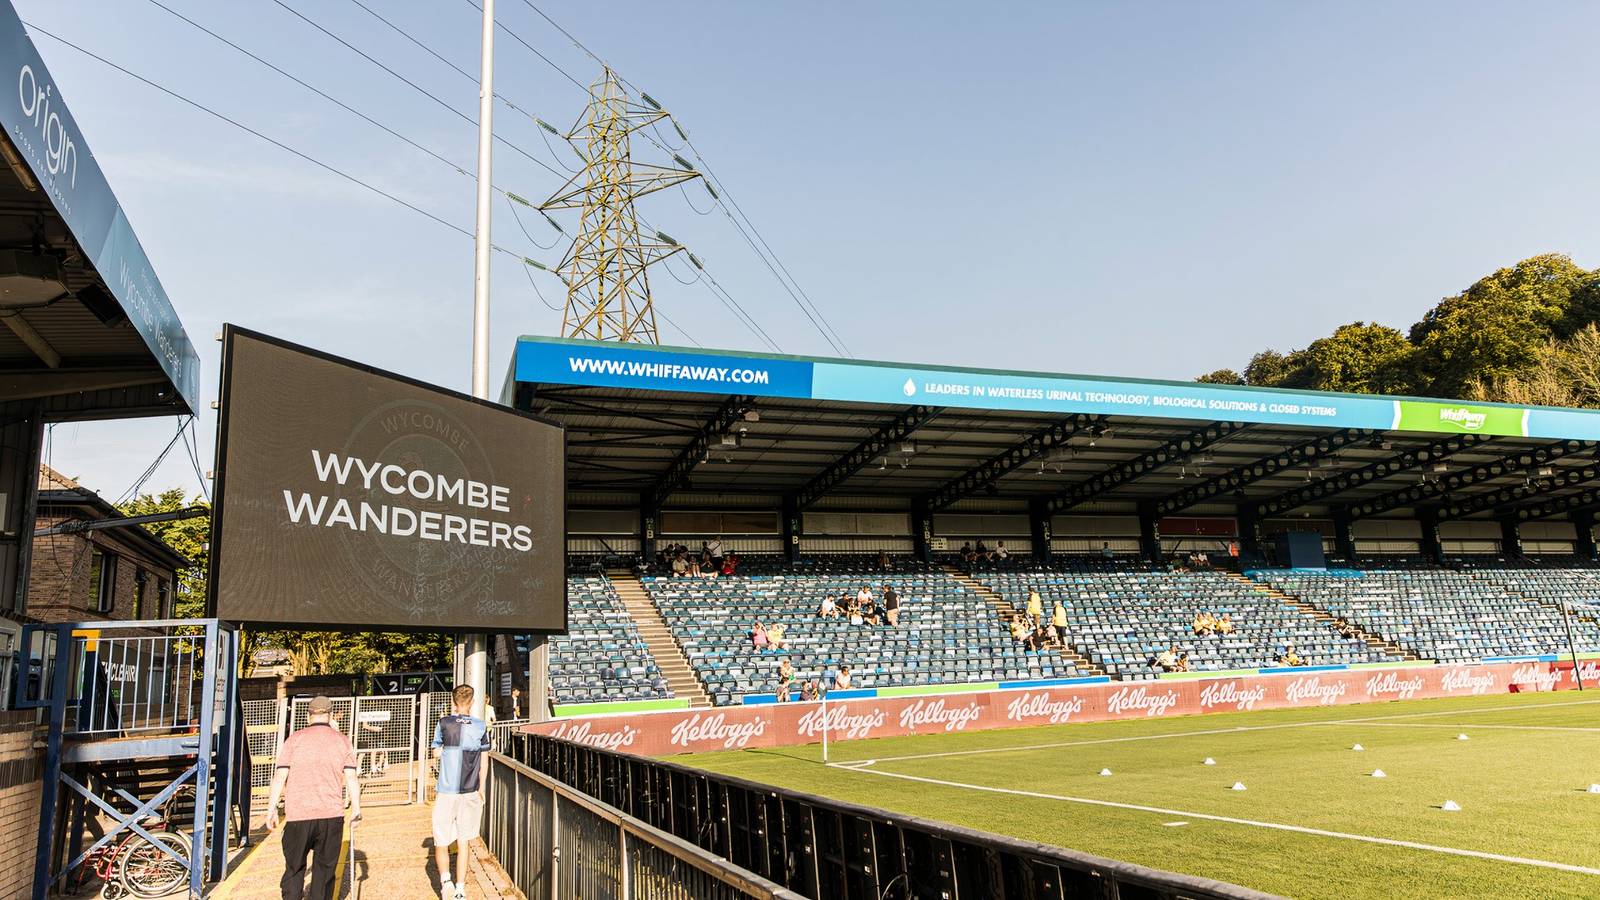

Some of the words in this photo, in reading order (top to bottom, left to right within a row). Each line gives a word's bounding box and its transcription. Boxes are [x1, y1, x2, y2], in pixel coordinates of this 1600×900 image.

[19, 64, 77, 190] Origin
[568, 357, 769, 385] WWW.WHIFFAWAY.COM
[925, 383, 970, 396] LEADERS
[973, 386, 985, 396] IN
[988, 387, 1044, 399] WATERLESS
[1046, 390, 1082, 401] URINAL
[1085, 392, 1151, 406] TECHNOLOGY,
[1153, 396, 1206, 409] BIOLOGICAL
[1208, 399, 1258, 412] SOLUTIONS
[1259, 403, 1267, 412] &
[1268, 403, 1300, 414] CLOSED
[1301, 405, 1337, 417] SYSTEMS
[380, 411, 470, 452] WYCOMBE
[311, 449, 510, 512] WYCOMBE
[283, 489, 533, 552] WANDERERS
[792, 535, 799, 545] B
[389, 681, 398, 693] 2
[1286, 676, 1346, 705] Kellogg's
[1367, 671, 1424, 698] Kellogg's
[1441, 668, 1495, 694] Kellogg's
[1512, 664, 1564, 690] Kellogg's
[1008, 692, 1083, 724] Kellogg's
[1108, 686, 1177, 716] Kellogg's
[1200, 679, 1265, 710] Kellogg's
[798, 702, 886, 738] Kellogg's
[900, 698, 982, 731] Kellogg's
[671, 713, 766, 749] Kellogg's
